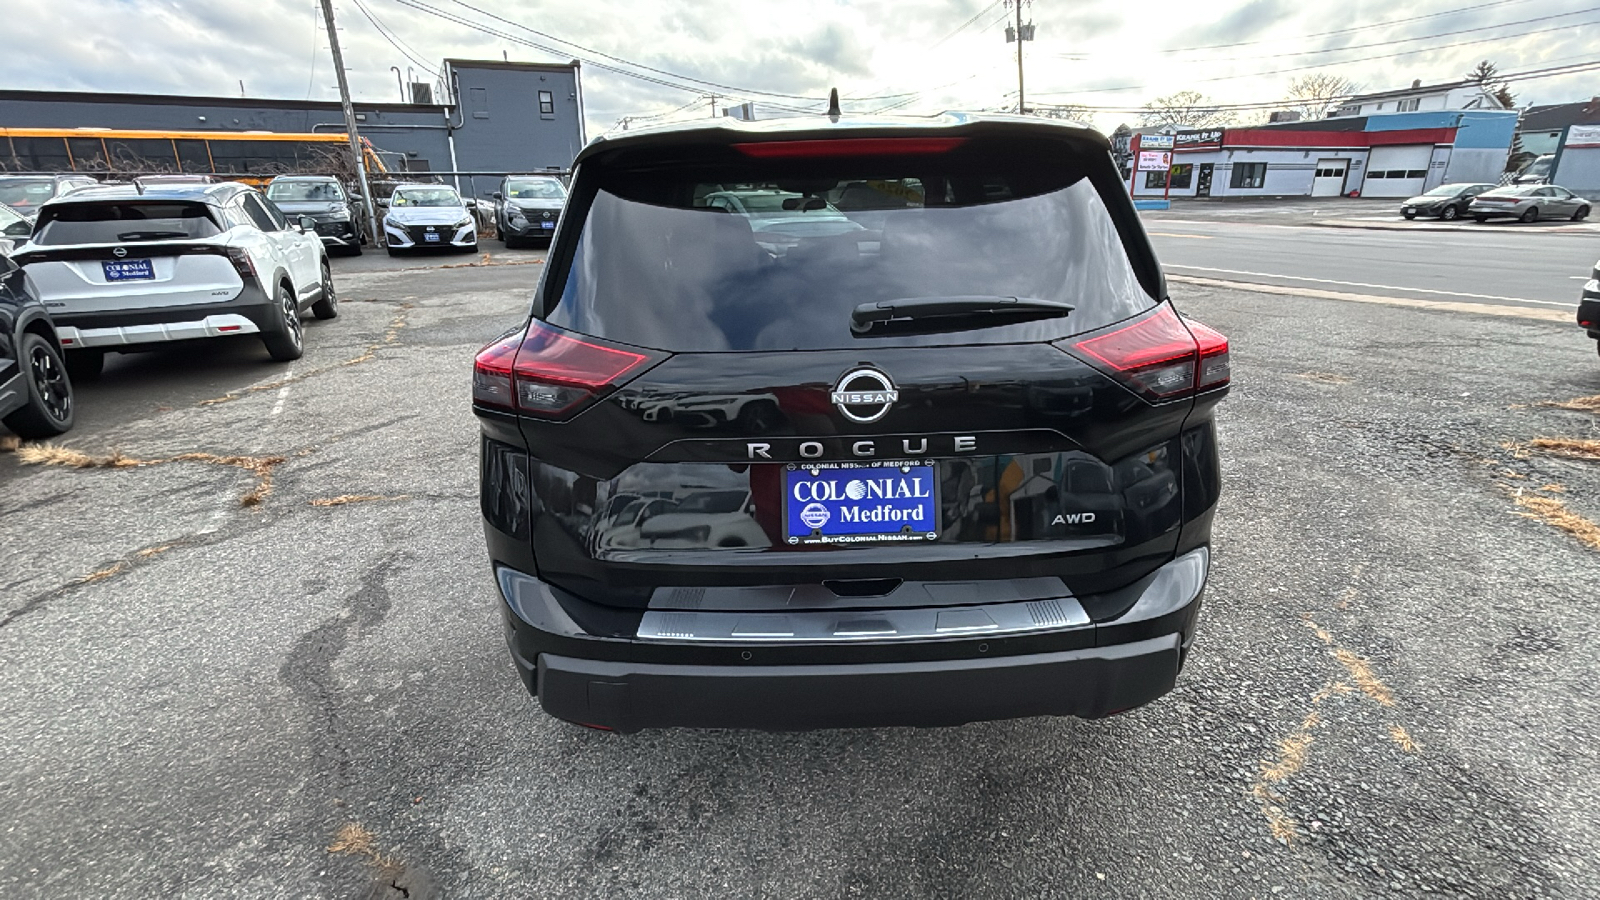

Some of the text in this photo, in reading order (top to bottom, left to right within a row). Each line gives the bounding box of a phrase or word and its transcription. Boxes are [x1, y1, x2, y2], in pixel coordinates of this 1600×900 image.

[106, 263, 149, 272] COLONIAL
[832, 393, 898, 403] NISSAN
[747, 436, 977, 459] ROGUE
[793, 478, 930, 502] COLONIAL
[840, 504, 924, 523] Medford
[1051, 512, 1096, 526] AWD
